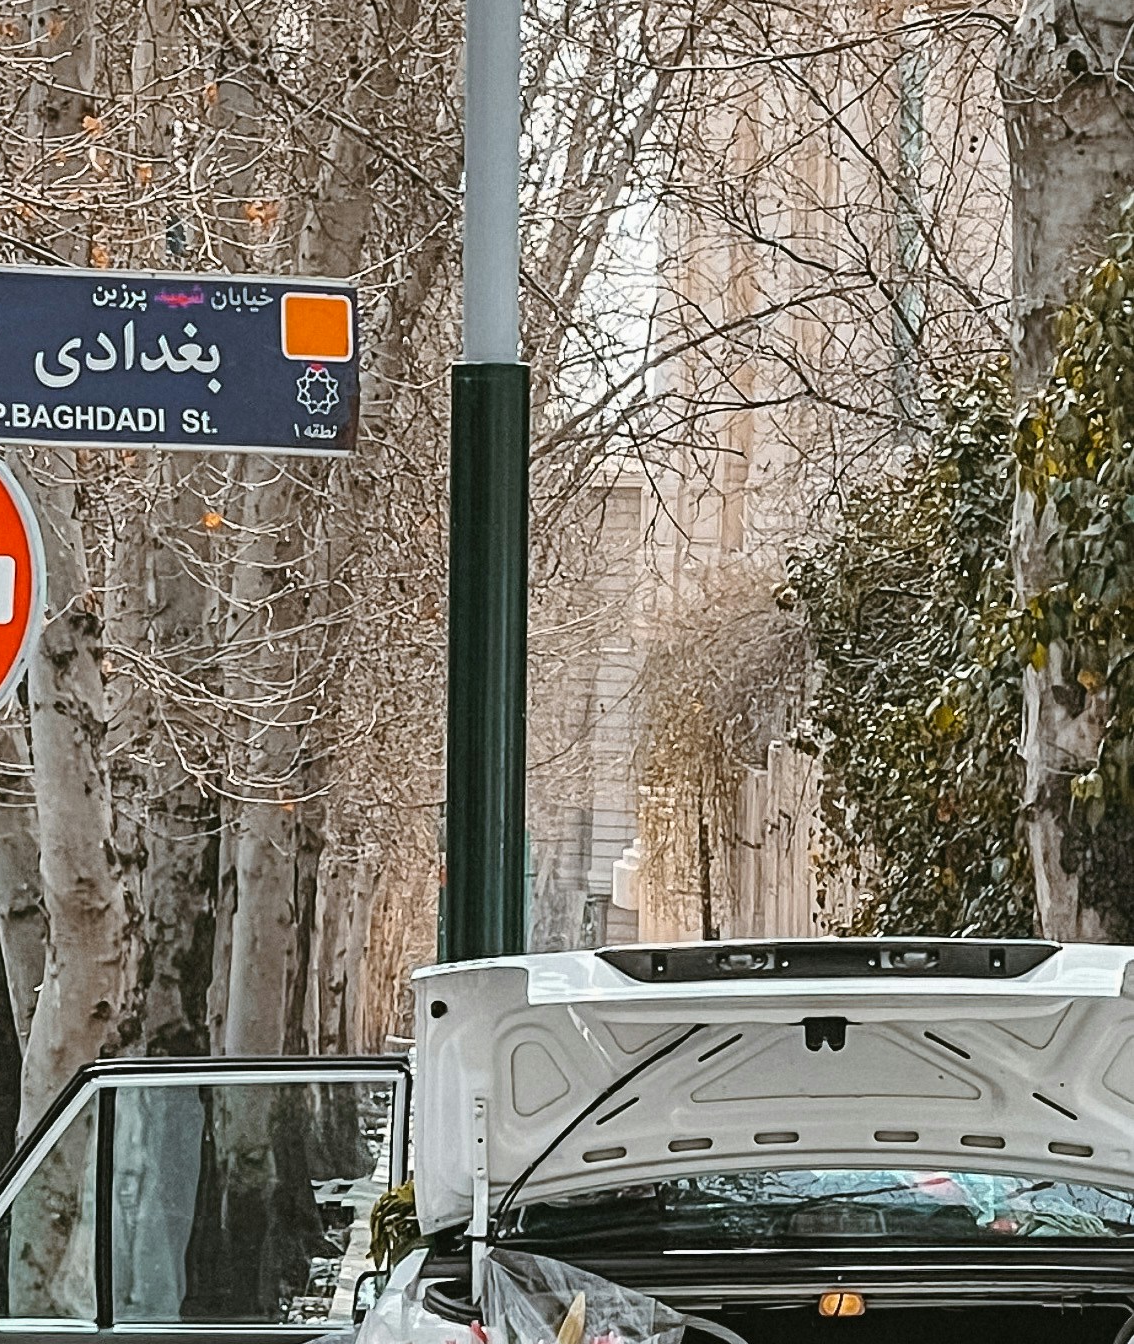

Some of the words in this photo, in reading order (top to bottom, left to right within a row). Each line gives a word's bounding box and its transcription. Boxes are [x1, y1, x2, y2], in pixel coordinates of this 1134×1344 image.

[92, 283, 147, 312] پرزین
[210, 286, 274, 313] خیابان
[34, 320, 222, 394] بغدادی
[182, 408, 218, 434] St.
